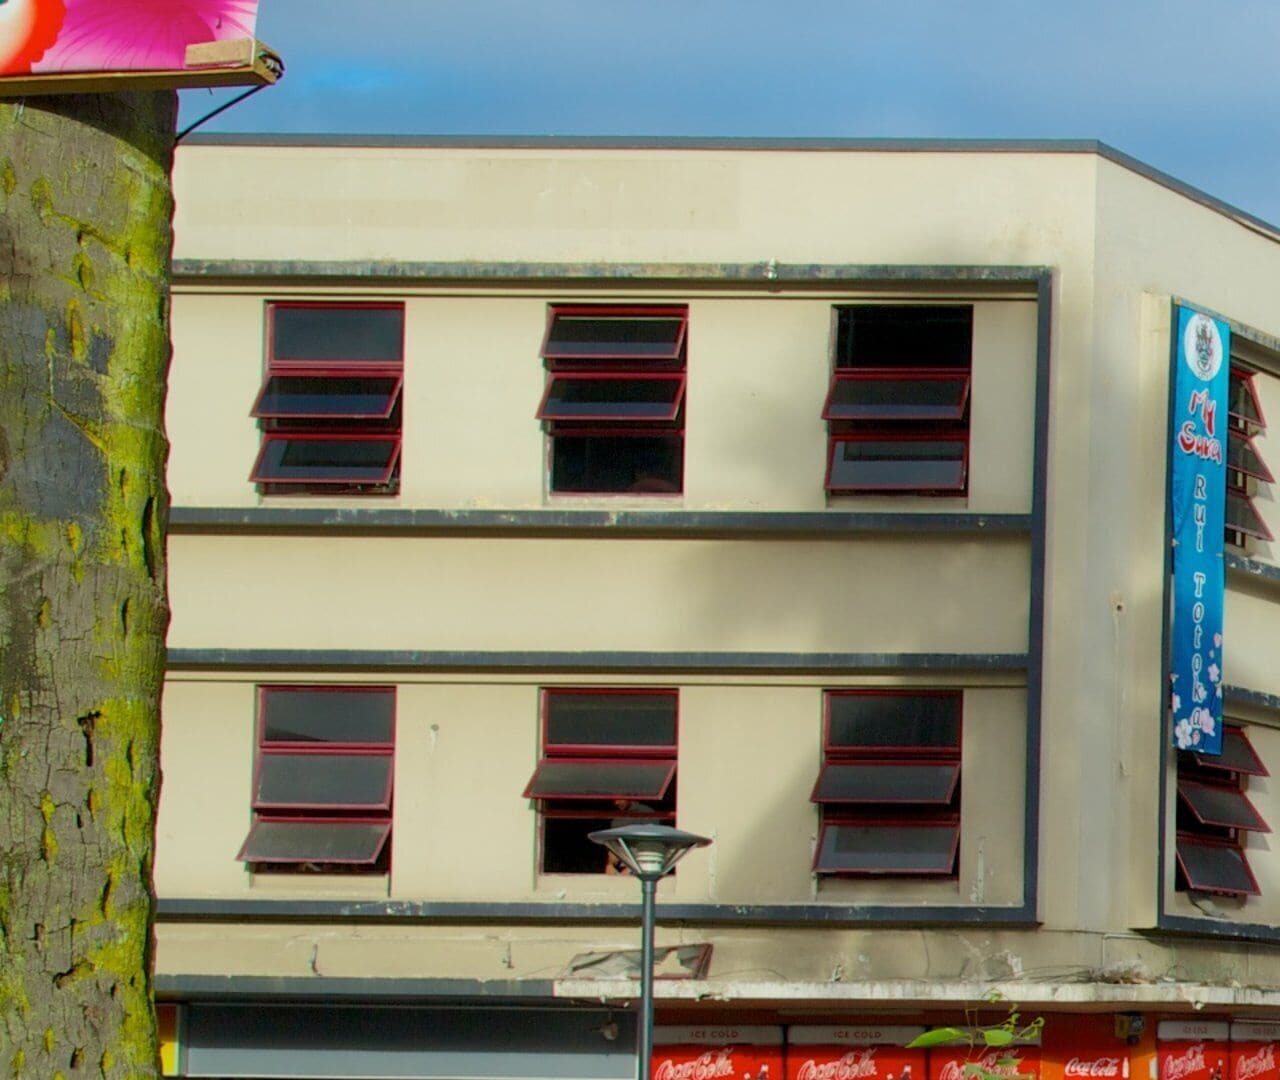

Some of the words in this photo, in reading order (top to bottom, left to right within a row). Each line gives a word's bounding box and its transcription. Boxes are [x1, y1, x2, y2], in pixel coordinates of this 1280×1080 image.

[1189, 389, 1217, 436] My
[1178, 421, 1223, 464] Suva
[1192, 572, 1205, 726] Totoka
[1064, 1056, 1120, 1078] Coca-Cola
